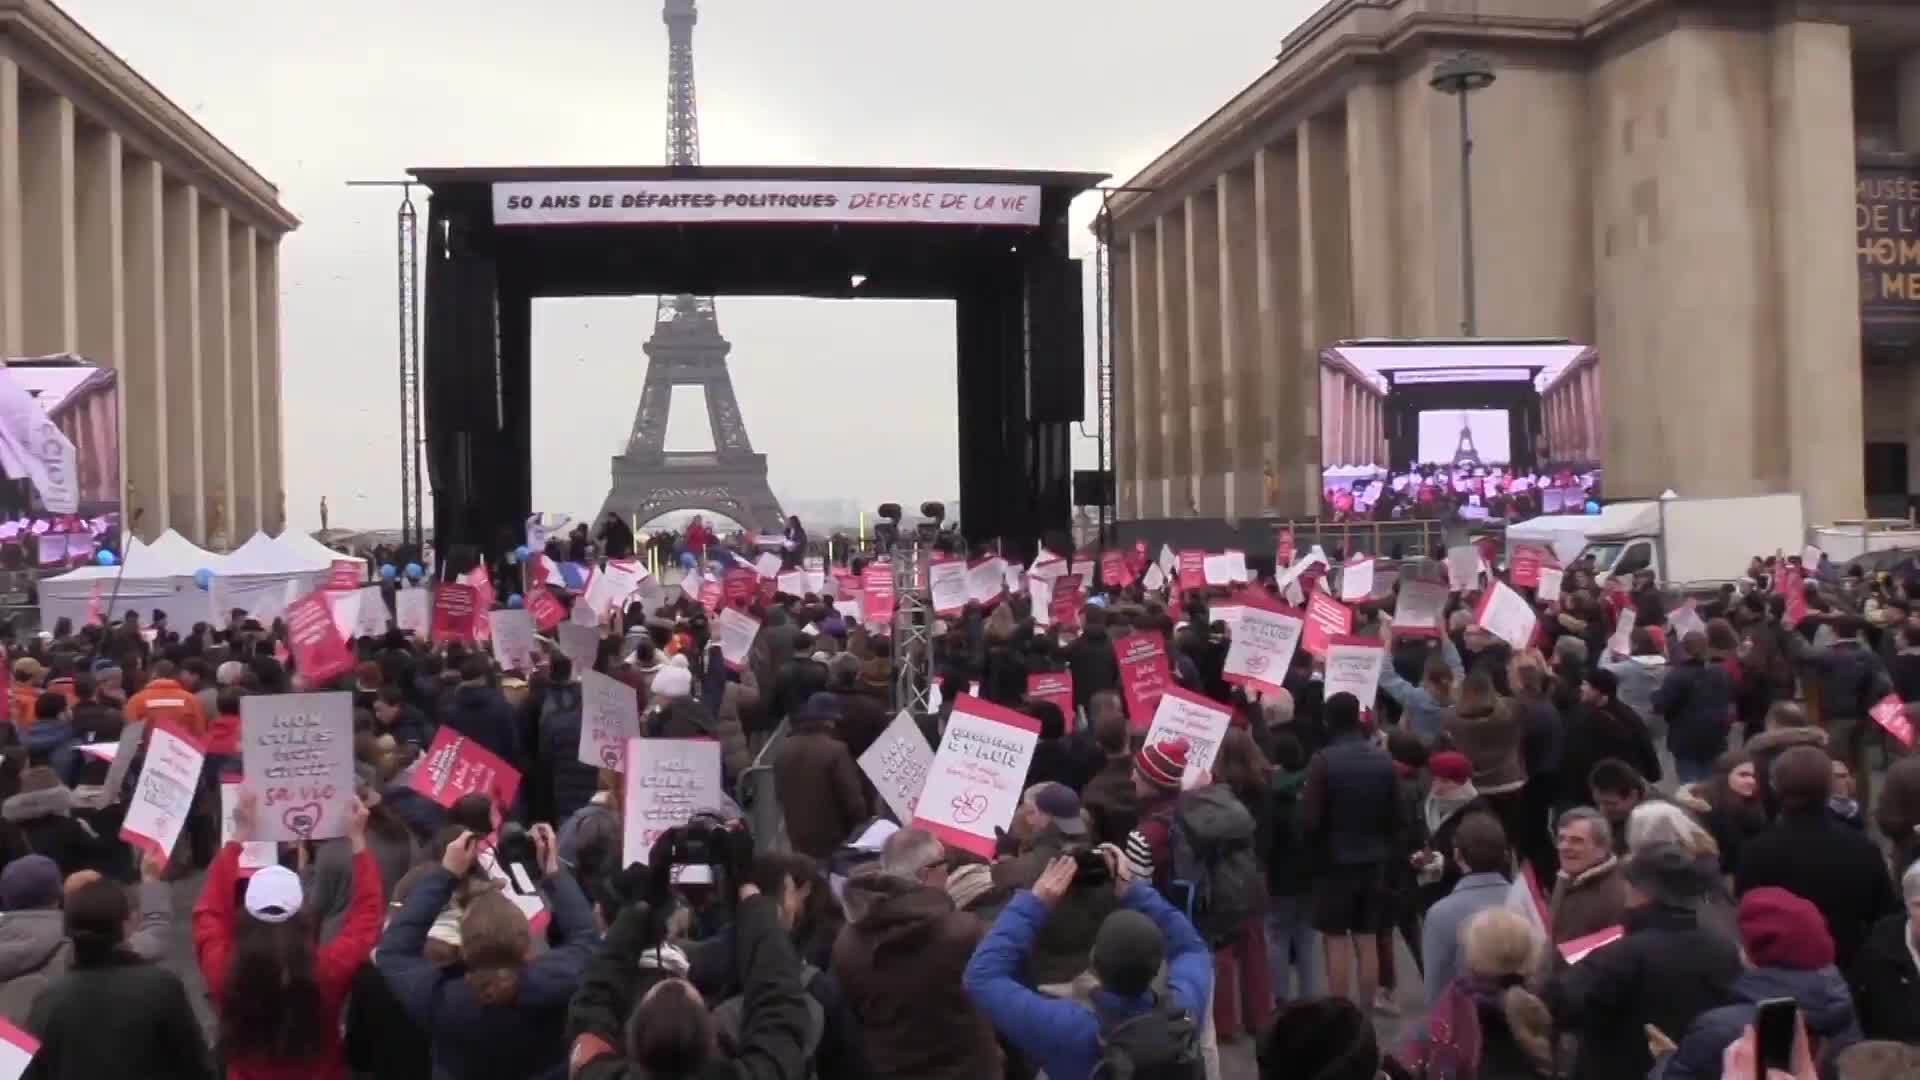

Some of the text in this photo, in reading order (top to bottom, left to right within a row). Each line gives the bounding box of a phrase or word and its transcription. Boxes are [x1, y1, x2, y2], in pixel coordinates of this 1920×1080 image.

[507, 195, 533, 209] 50
[540, 195, 580, 209] ANS
[589, 195, 613, 208] DE
[722, 193, 838, 208] POLITIQUES
[940, 193, 967, 209] DE
[975, 195, 996, 210] LA
[1001, 195, 1027, 212] VIE
[1855, 203, 1889, 232] DE
